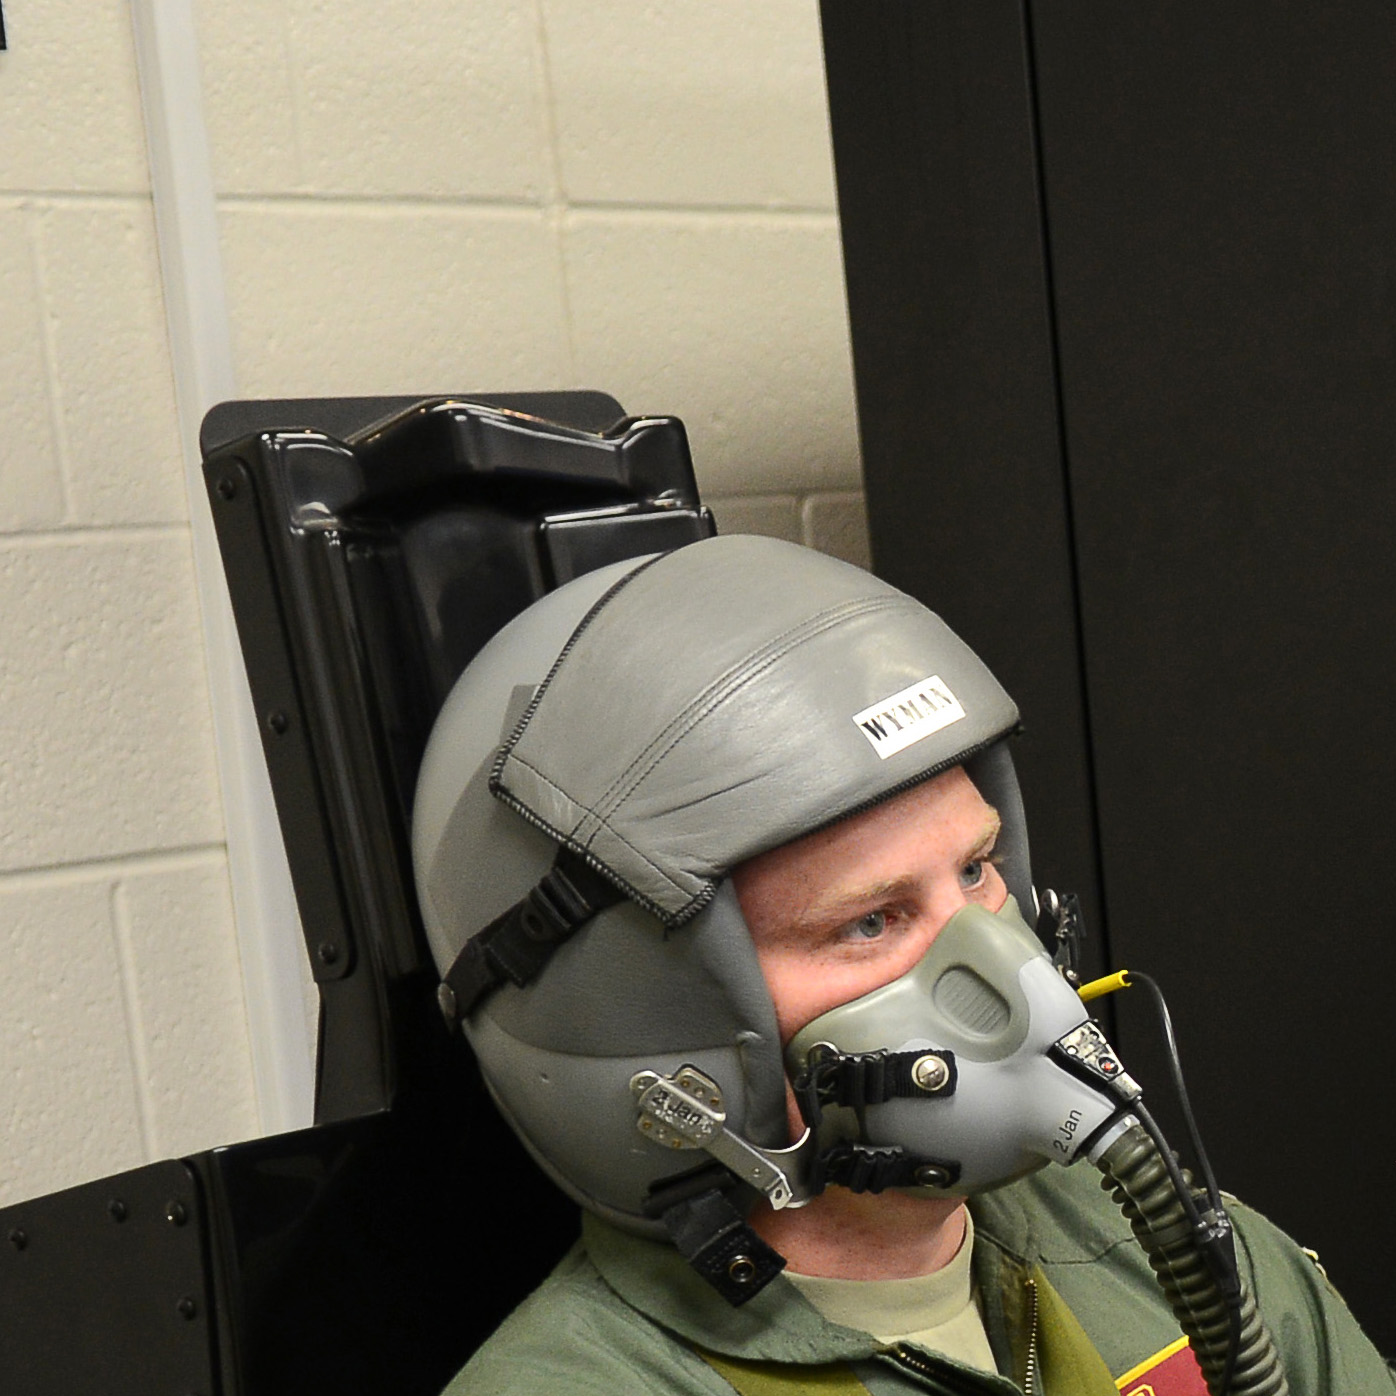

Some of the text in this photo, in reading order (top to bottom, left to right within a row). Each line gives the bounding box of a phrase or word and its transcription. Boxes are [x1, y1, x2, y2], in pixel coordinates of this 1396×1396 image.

[860, 685, 953, 742] WYMAN
[667, 1100, 704, 1126] Jan
[1052, 1109, 1083, 1154] 2 Jan
